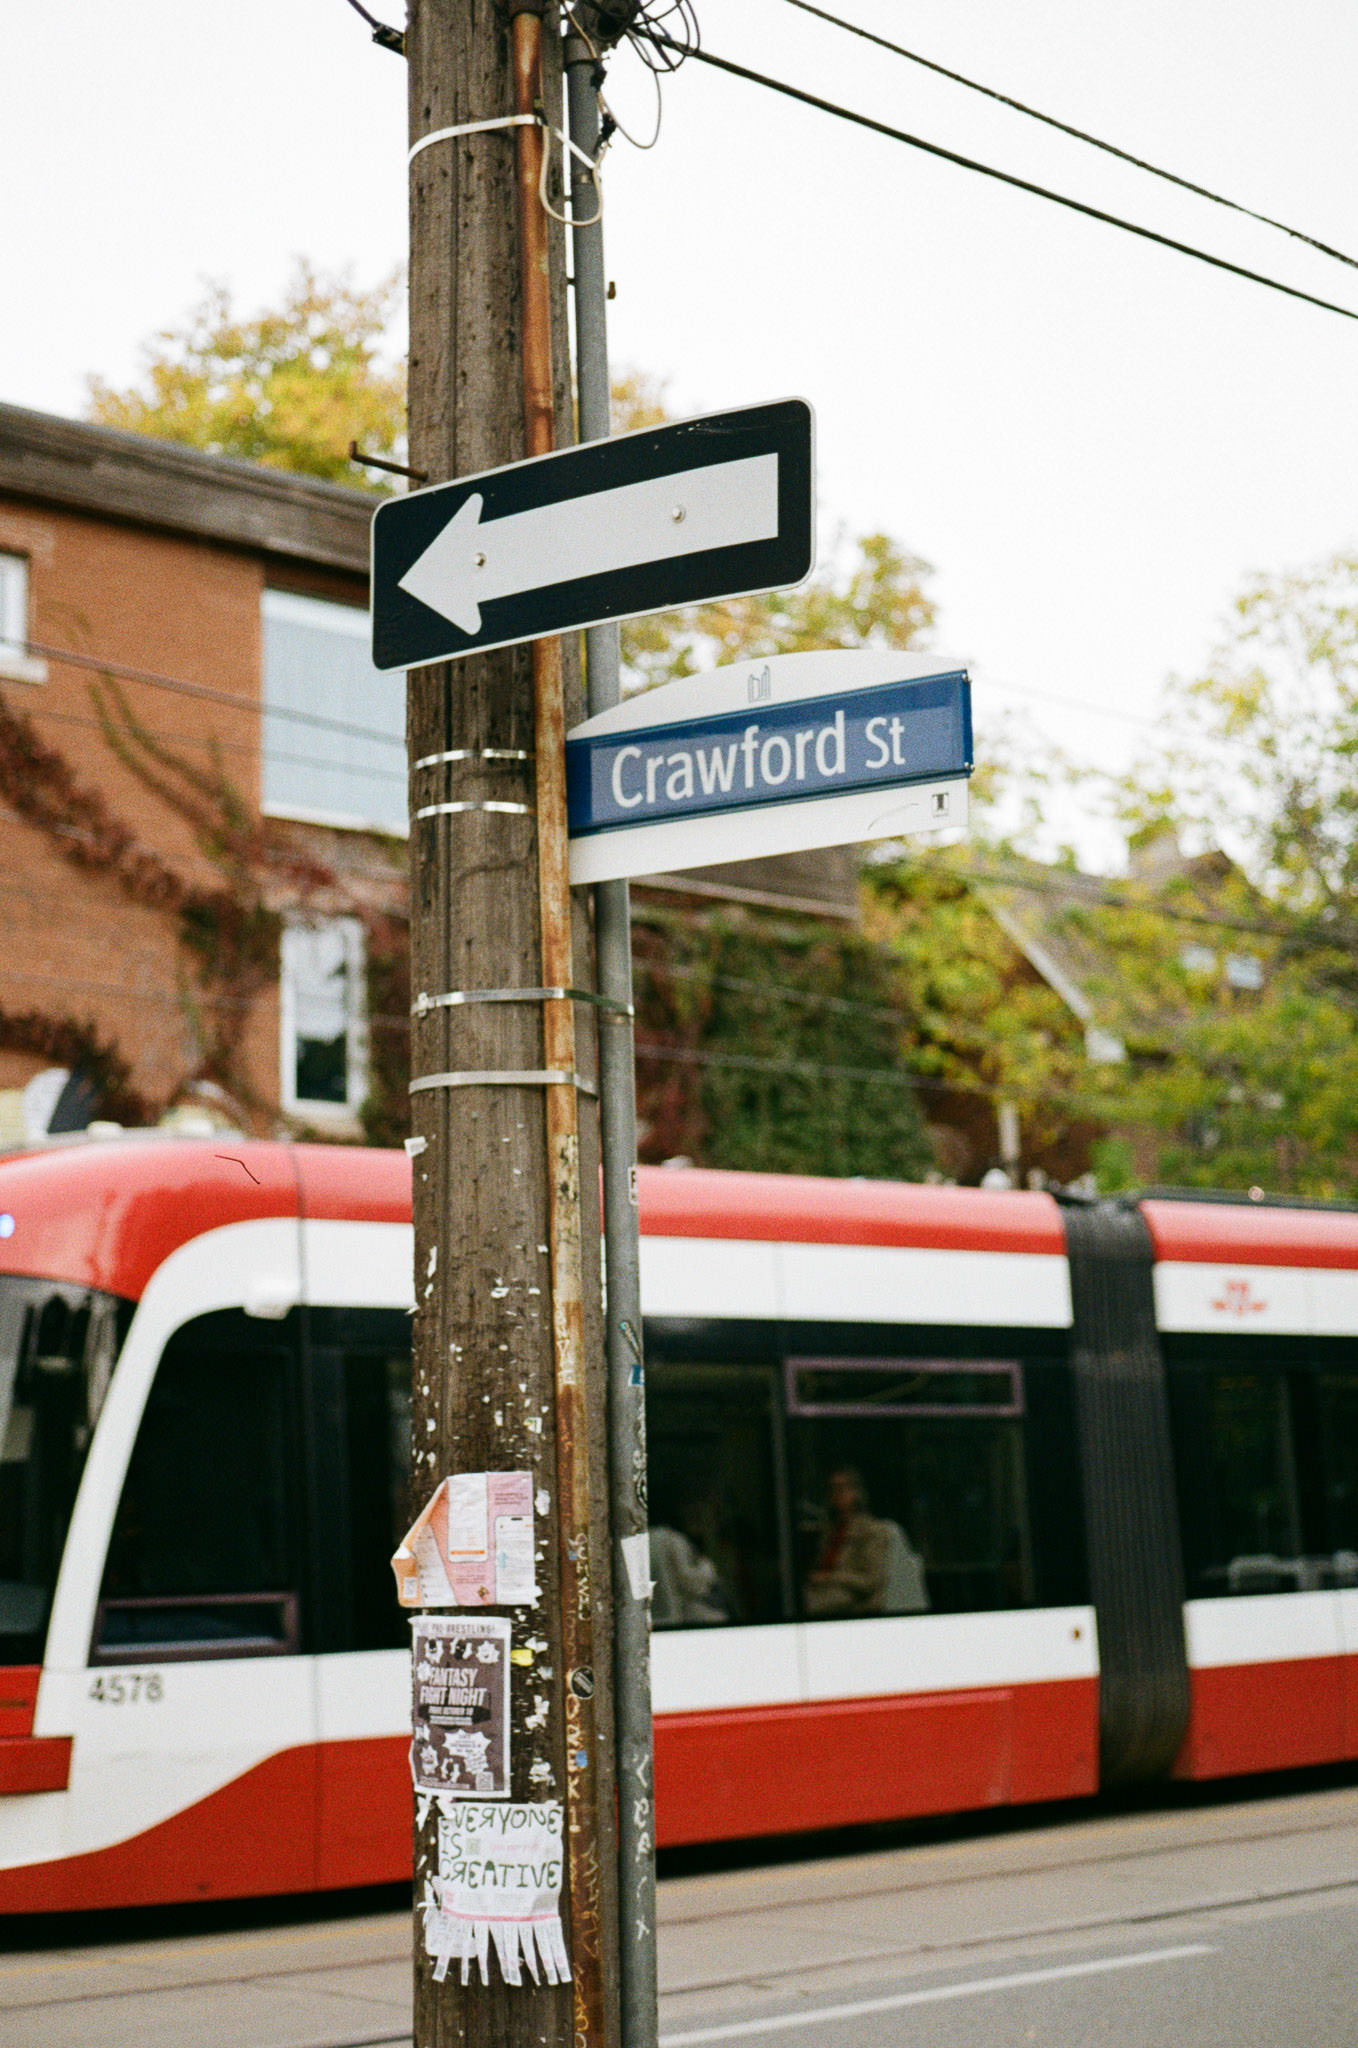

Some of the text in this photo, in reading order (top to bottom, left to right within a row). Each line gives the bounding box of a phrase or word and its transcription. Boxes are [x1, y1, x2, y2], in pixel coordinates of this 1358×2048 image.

[612, 710, 906, 808] Crawford St
[89, 1673, 163, 1703] 4578
[429, 1666, 478, 1687] FANTASY
[448, 1687, 488, 1707] NIGHT
[441, 1832, 463, 1860] IS
[440, 1859, 561, 1889] CREATIVE
